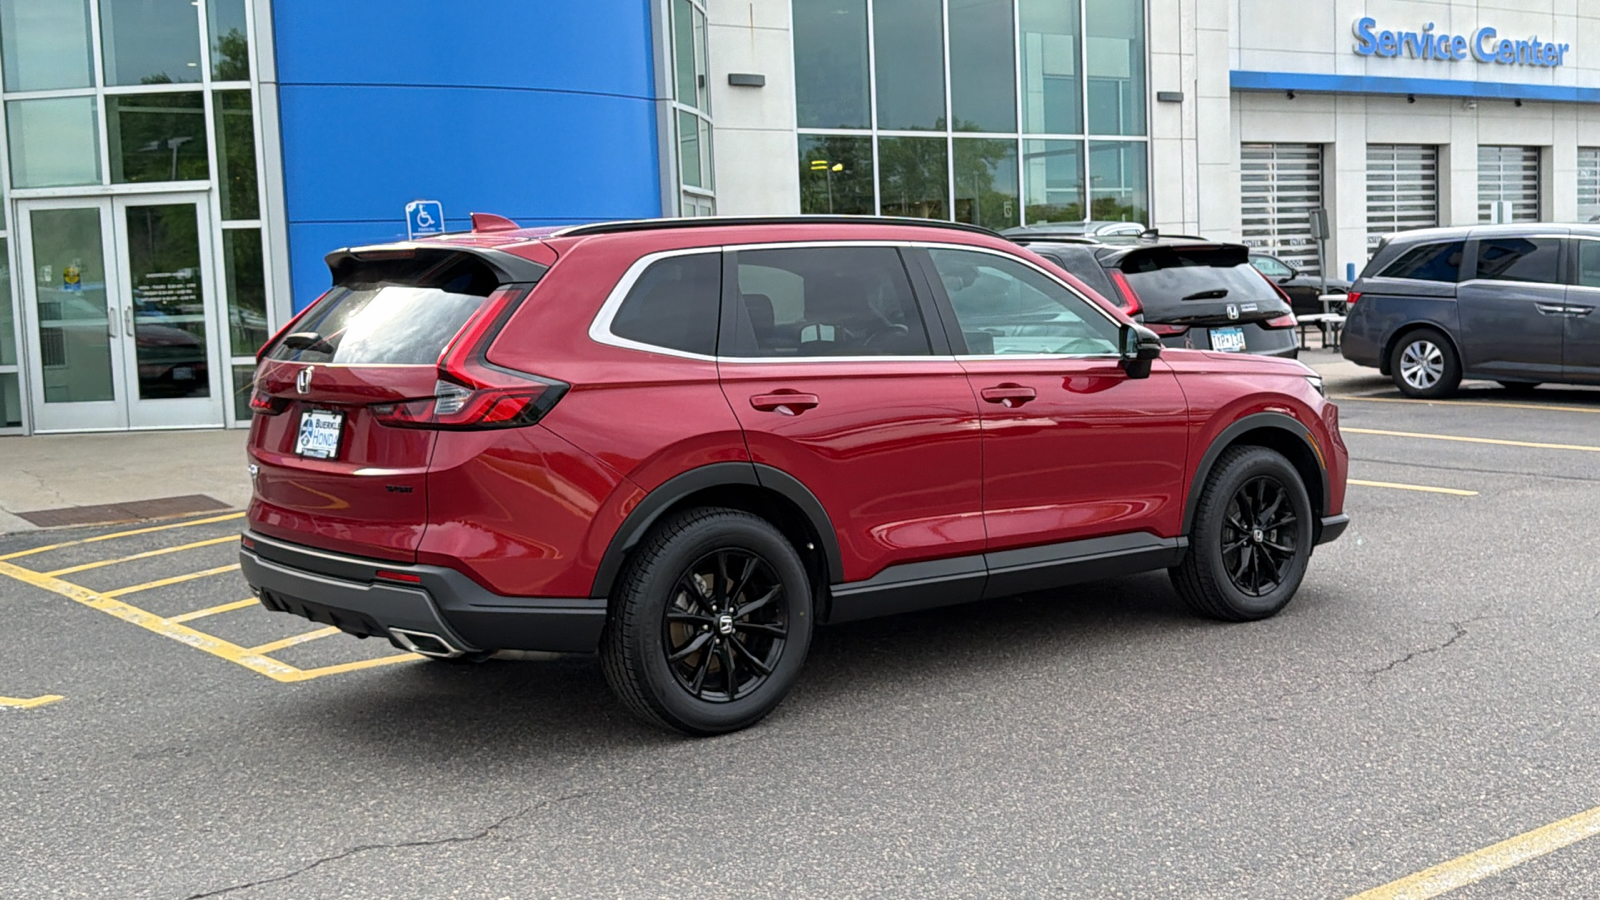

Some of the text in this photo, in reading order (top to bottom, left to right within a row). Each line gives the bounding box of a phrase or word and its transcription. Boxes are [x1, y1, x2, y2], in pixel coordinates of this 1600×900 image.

[1352, 17, 1570, 67] Service Center
[312, 430, 338, 446] HONDA
